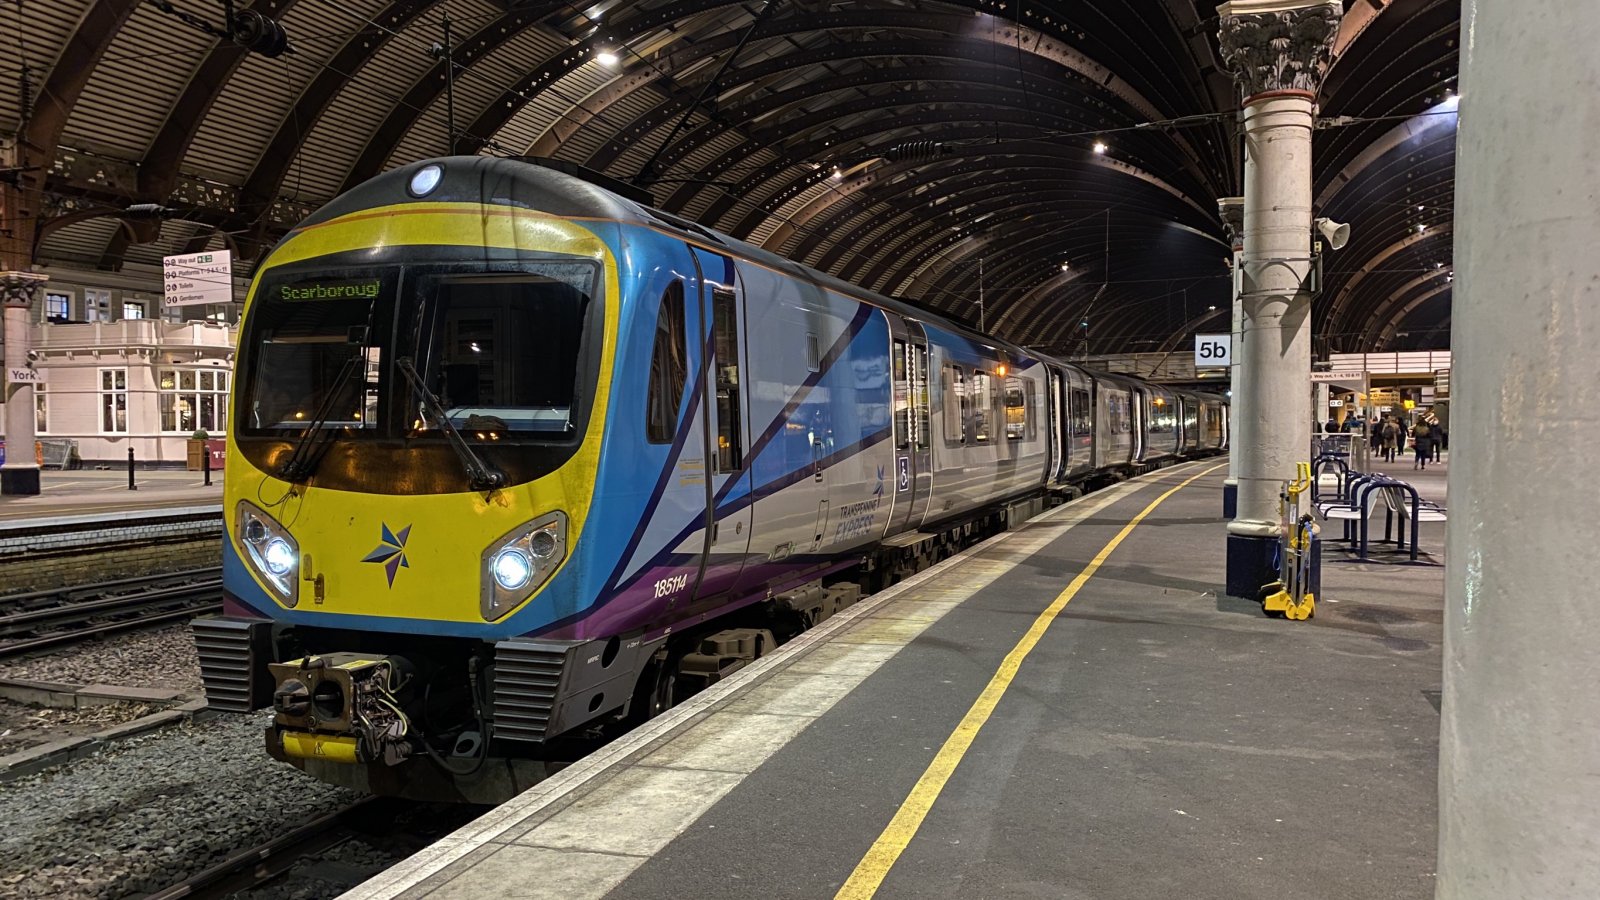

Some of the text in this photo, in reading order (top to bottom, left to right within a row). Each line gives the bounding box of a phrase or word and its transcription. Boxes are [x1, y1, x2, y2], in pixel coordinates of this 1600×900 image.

[1200, 342, 1226, 359] 5b
[12, 370, 36, 380] York
[654, 574, 687, 598] 185114
